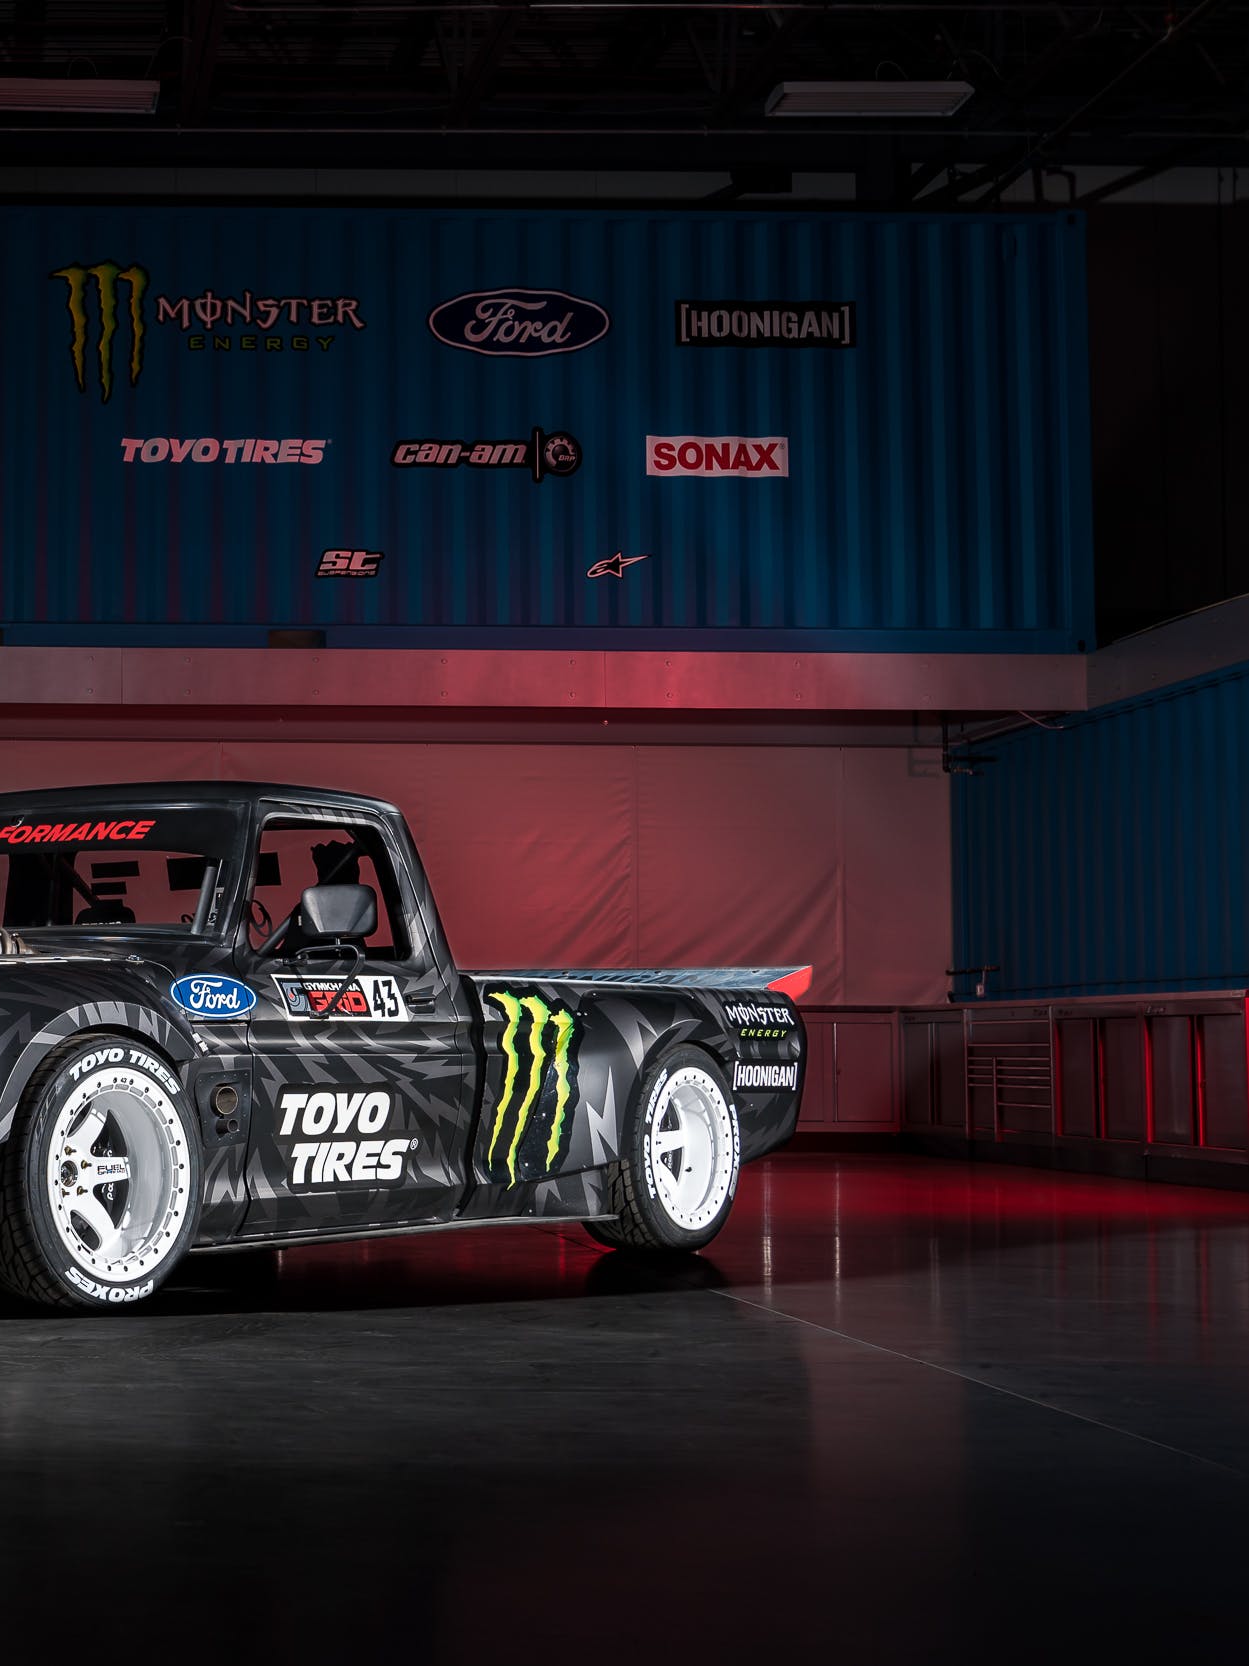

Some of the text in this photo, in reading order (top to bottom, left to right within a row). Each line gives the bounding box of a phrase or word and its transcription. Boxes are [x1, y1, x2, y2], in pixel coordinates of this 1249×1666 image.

[156, 290, 365, 331] MONSTER
[463, 299, 573, 345] Ford
[188, 336, 334, 350] ENERGY
[120, 438, 327, 464] TOYO TIRES
[392, 442, 528, 465] can-am
[653, 442, 780, 471] SONAX
[189, 979, 241, 1010] Ford
[373, 979, 400, 1018] 43
[725, 1002, 795, 1026] MONSTER
[740, 1028, 787, 1038] ENERGY
[69, 1047, 181, 1095] TOYO TIRES
[279, 1091, 391, 1136] TOYO
[64, 1266, 154, 1303] PROXES
